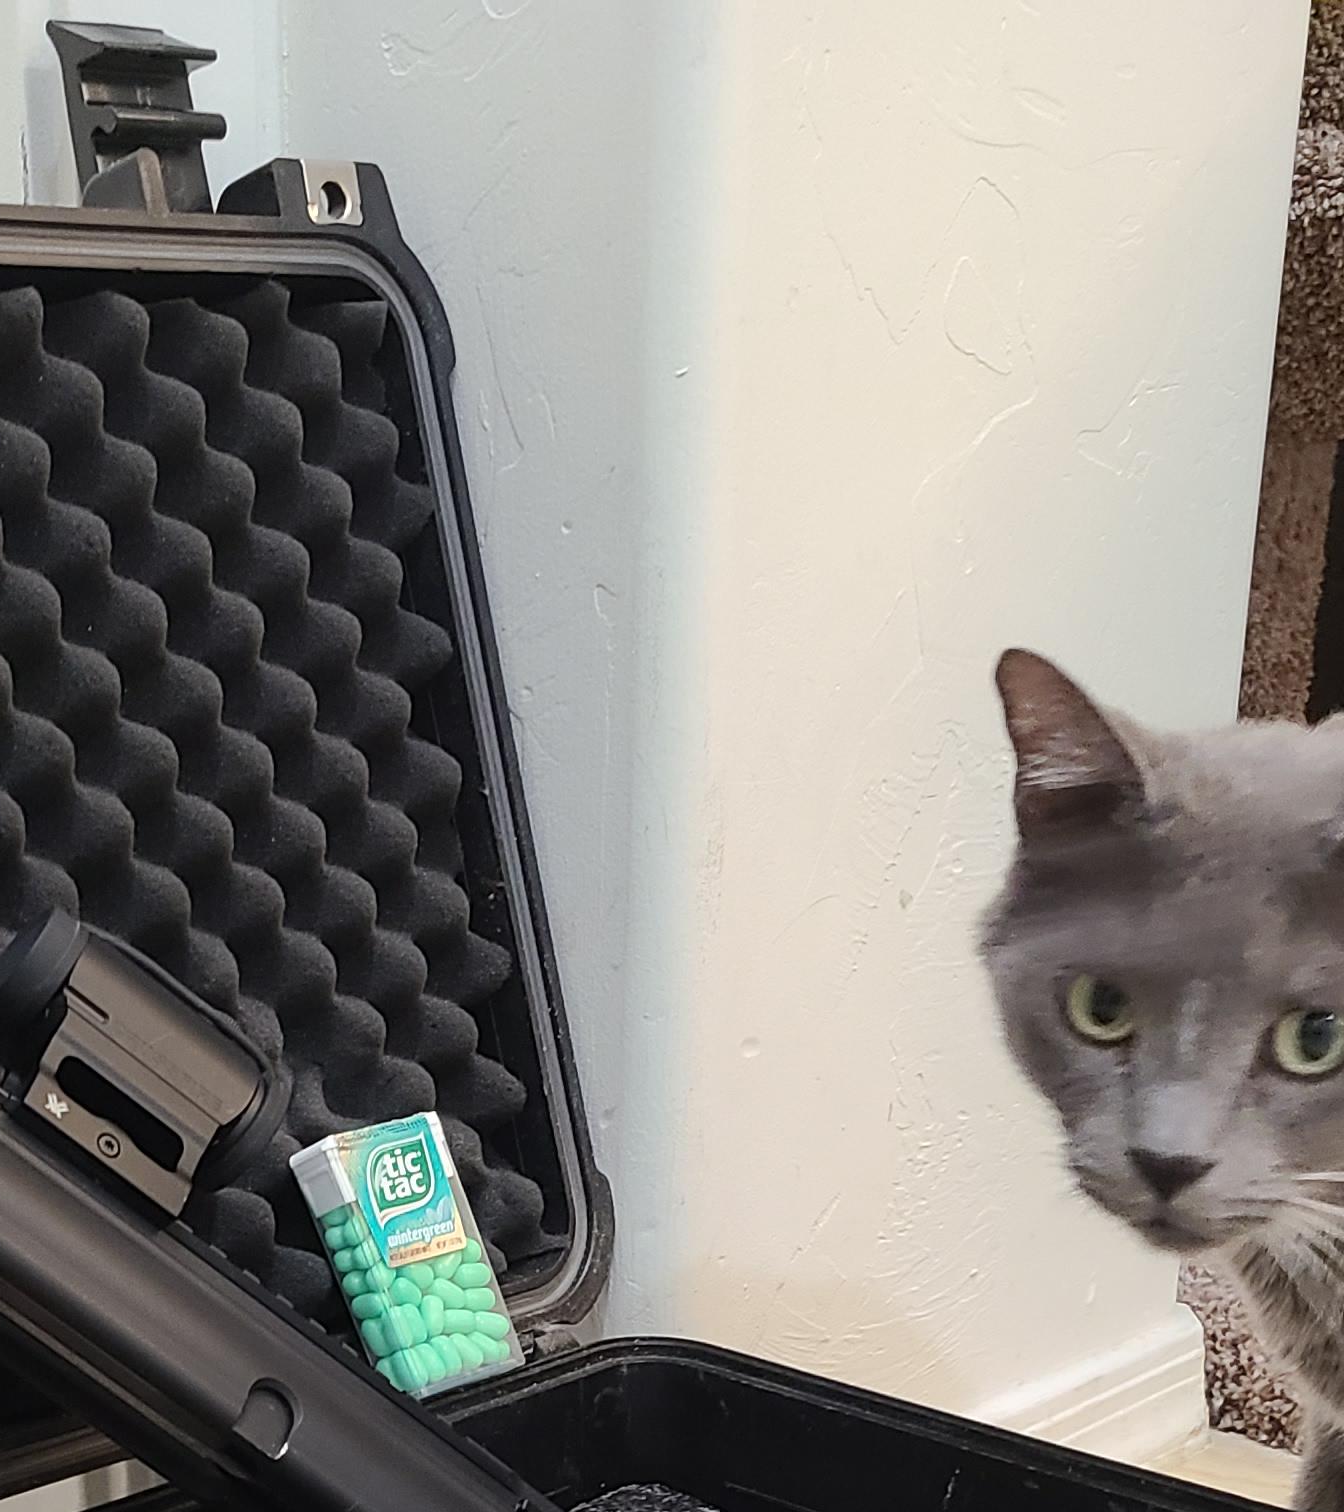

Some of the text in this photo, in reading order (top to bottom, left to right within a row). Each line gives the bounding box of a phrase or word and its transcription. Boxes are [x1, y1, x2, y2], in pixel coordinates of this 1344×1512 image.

[382, 1149, 421, 1178] tic
[381, 1172, 426, 1201] tac
[387, 1221, 454, 1248] wintergreen
